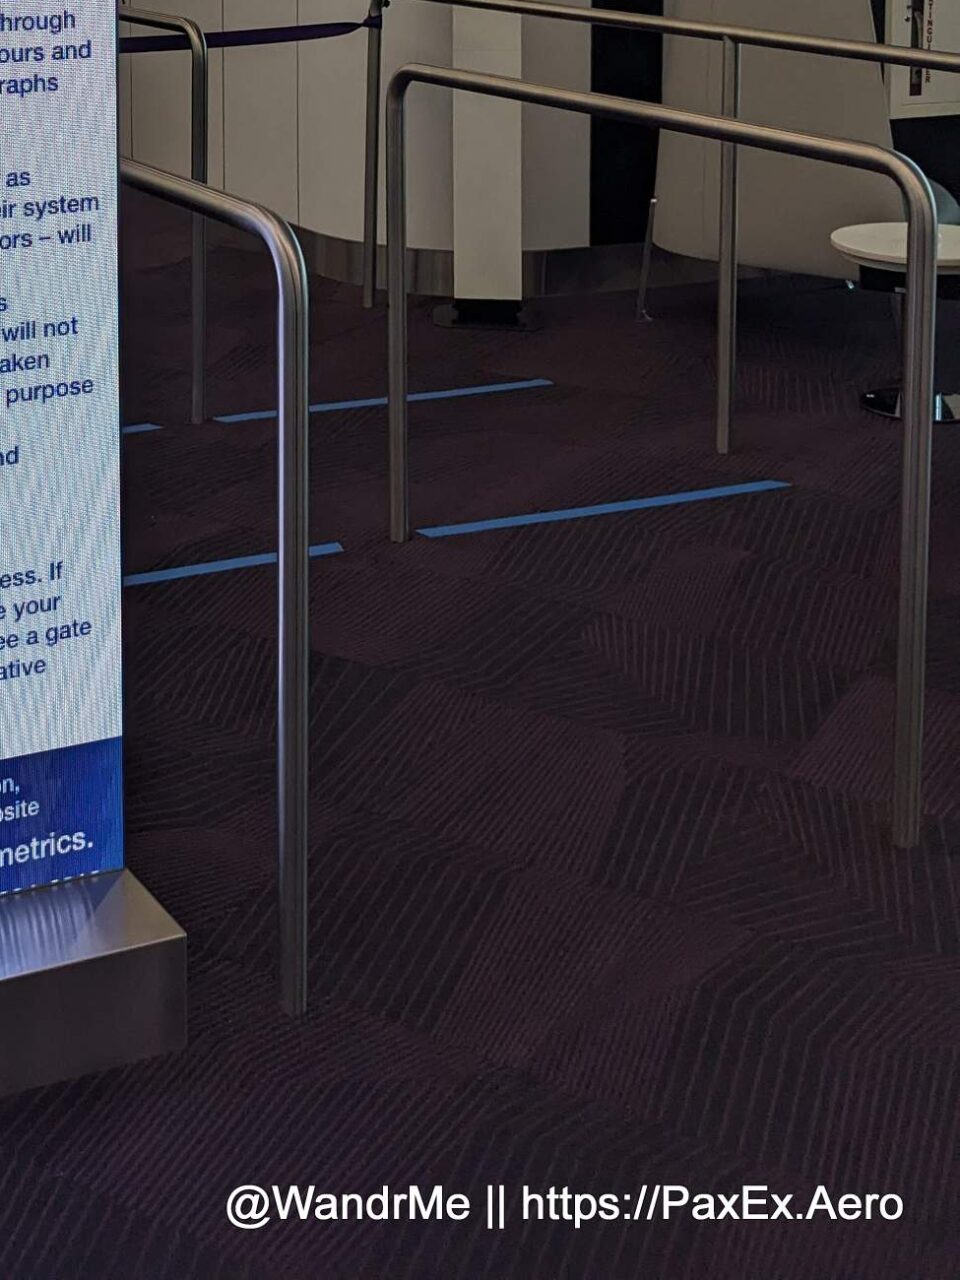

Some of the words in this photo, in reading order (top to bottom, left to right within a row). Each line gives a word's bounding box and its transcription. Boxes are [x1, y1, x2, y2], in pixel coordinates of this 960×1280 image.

[5, 170, 31, 187] as
[22, 195, 99, 221] system
[57, 223, 91, 244] will
[0, 320, 36, 342] will
[43, 316, 78, 337] not
[5, 378, 93, 408] purpose
[48, 560, 62, 581] If
[25, 630, 39, 645] a
[44, 619, 91, 647] gate
